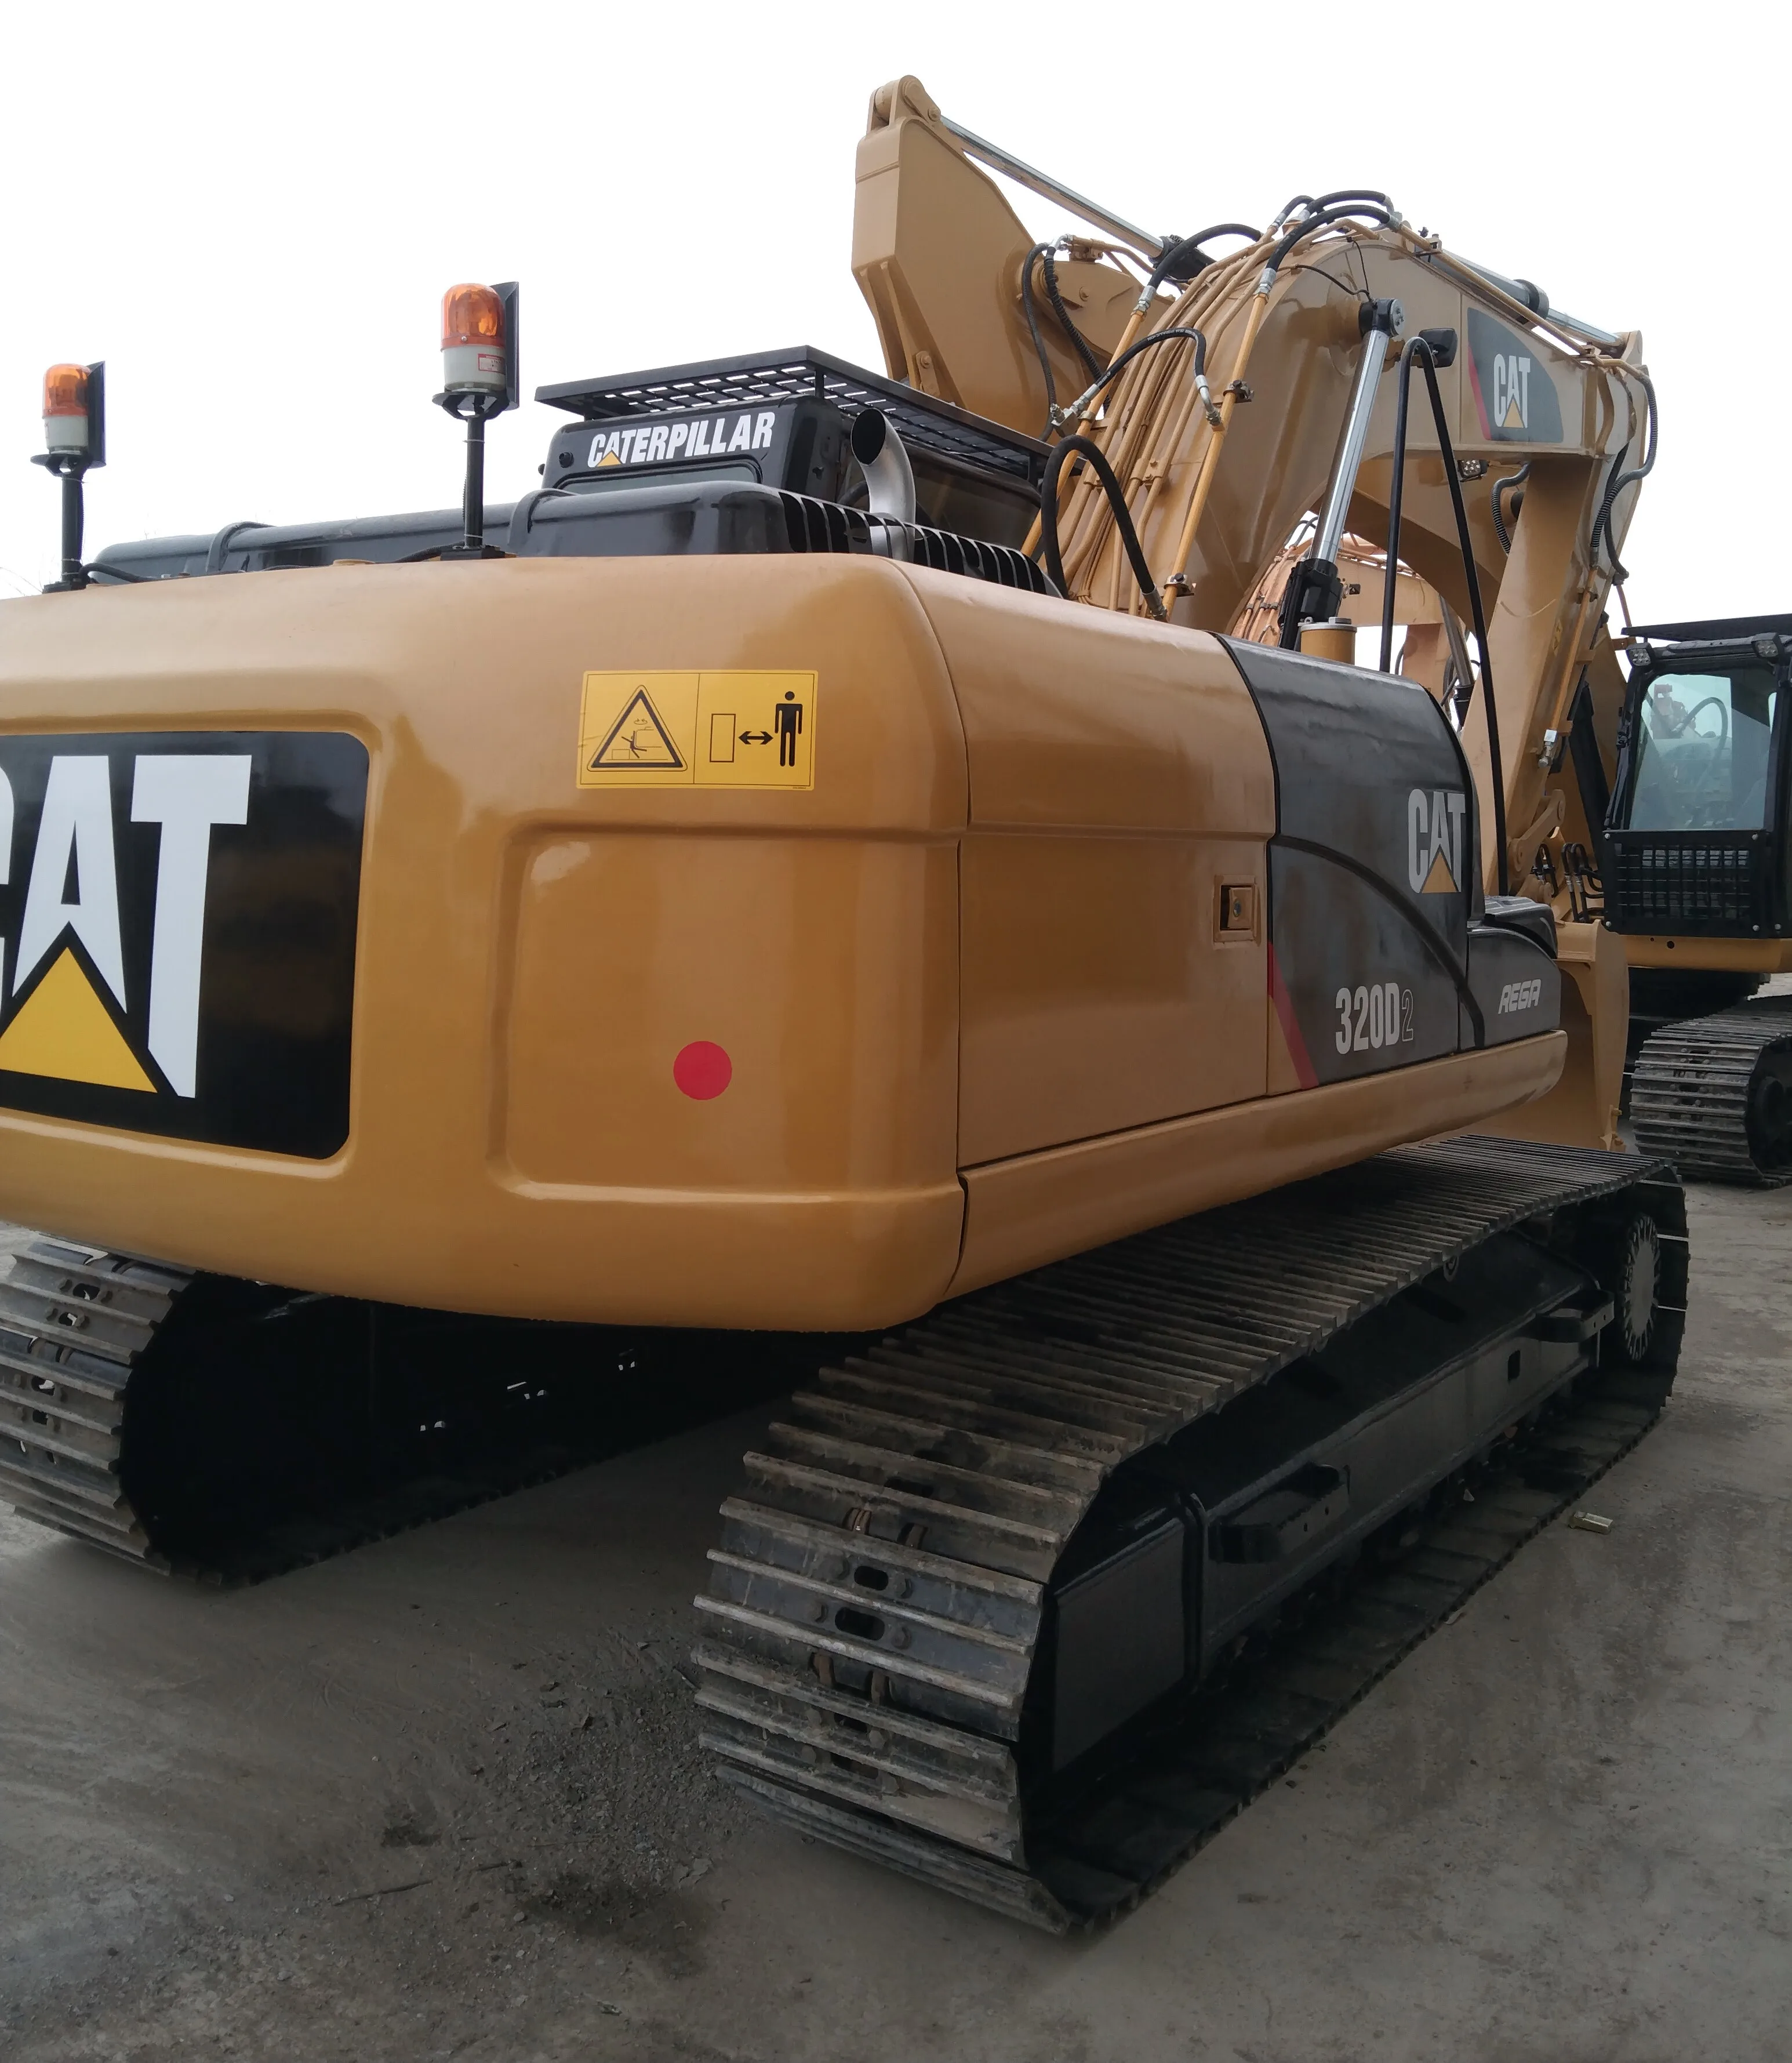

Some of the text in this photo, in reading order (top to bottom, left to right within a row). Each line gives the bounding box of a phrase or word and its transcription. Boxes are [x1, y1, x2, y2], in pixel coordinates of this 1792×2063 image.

[1493, 354, 1531, 428] CAT
[587, 412, 775, 468] CATERPILLAR
[1408, 789, 1466, 894] CAT
[0, 754, 252, 1098] AT
